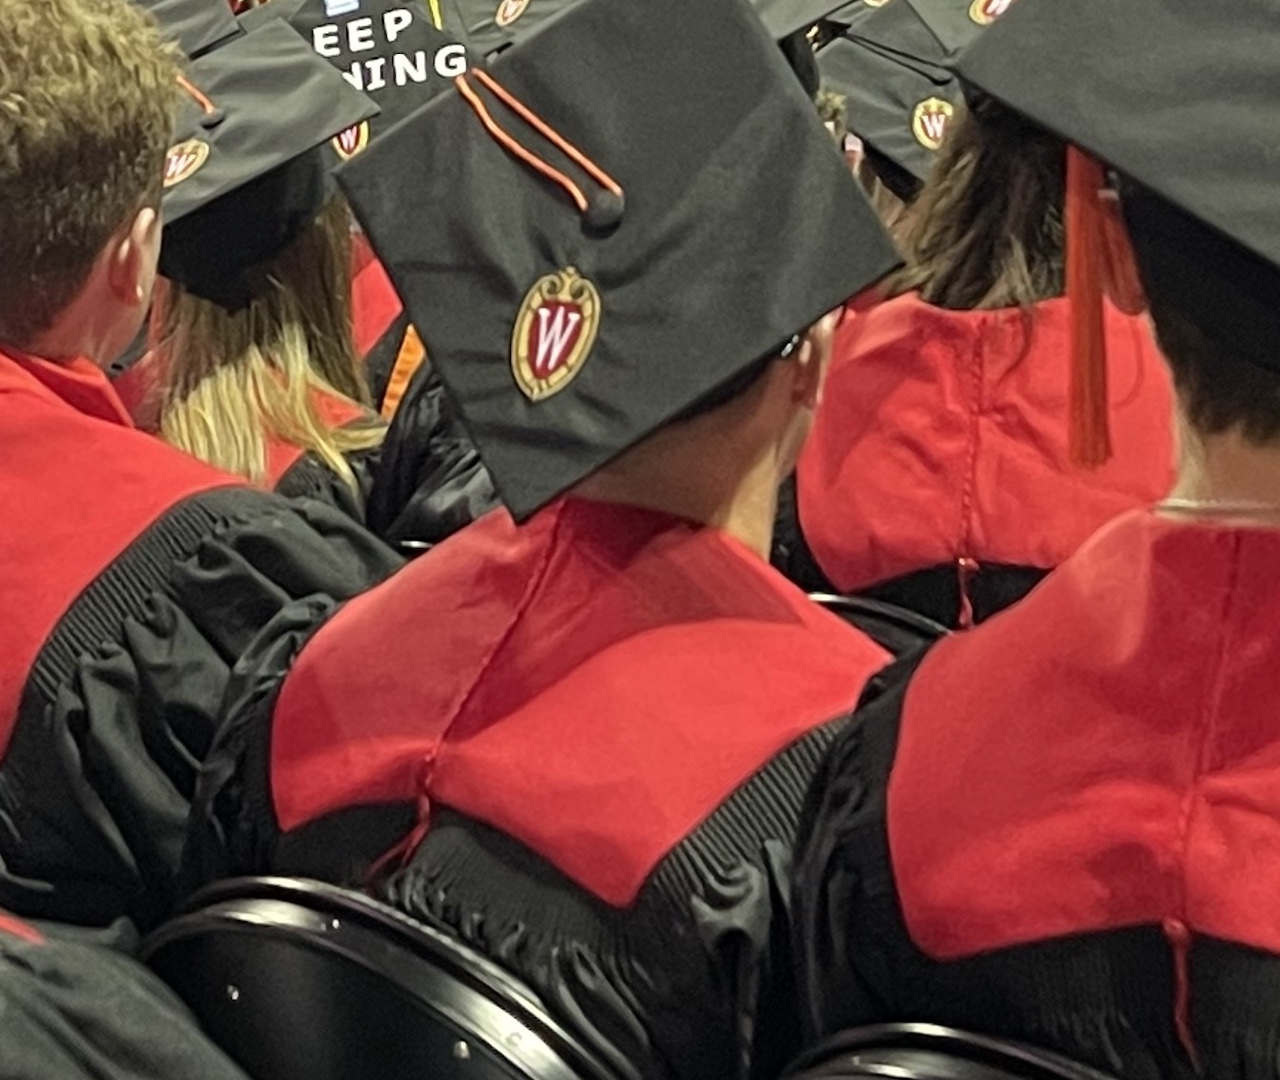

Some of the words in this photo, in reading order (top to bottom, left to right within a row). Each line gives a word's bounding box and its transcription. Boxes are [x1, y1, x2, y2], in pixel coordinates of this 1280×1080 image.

[313, 8, 413, 58] EEP
[342, 44, 467, 92] NING
[535, 305, 581, 370] W
